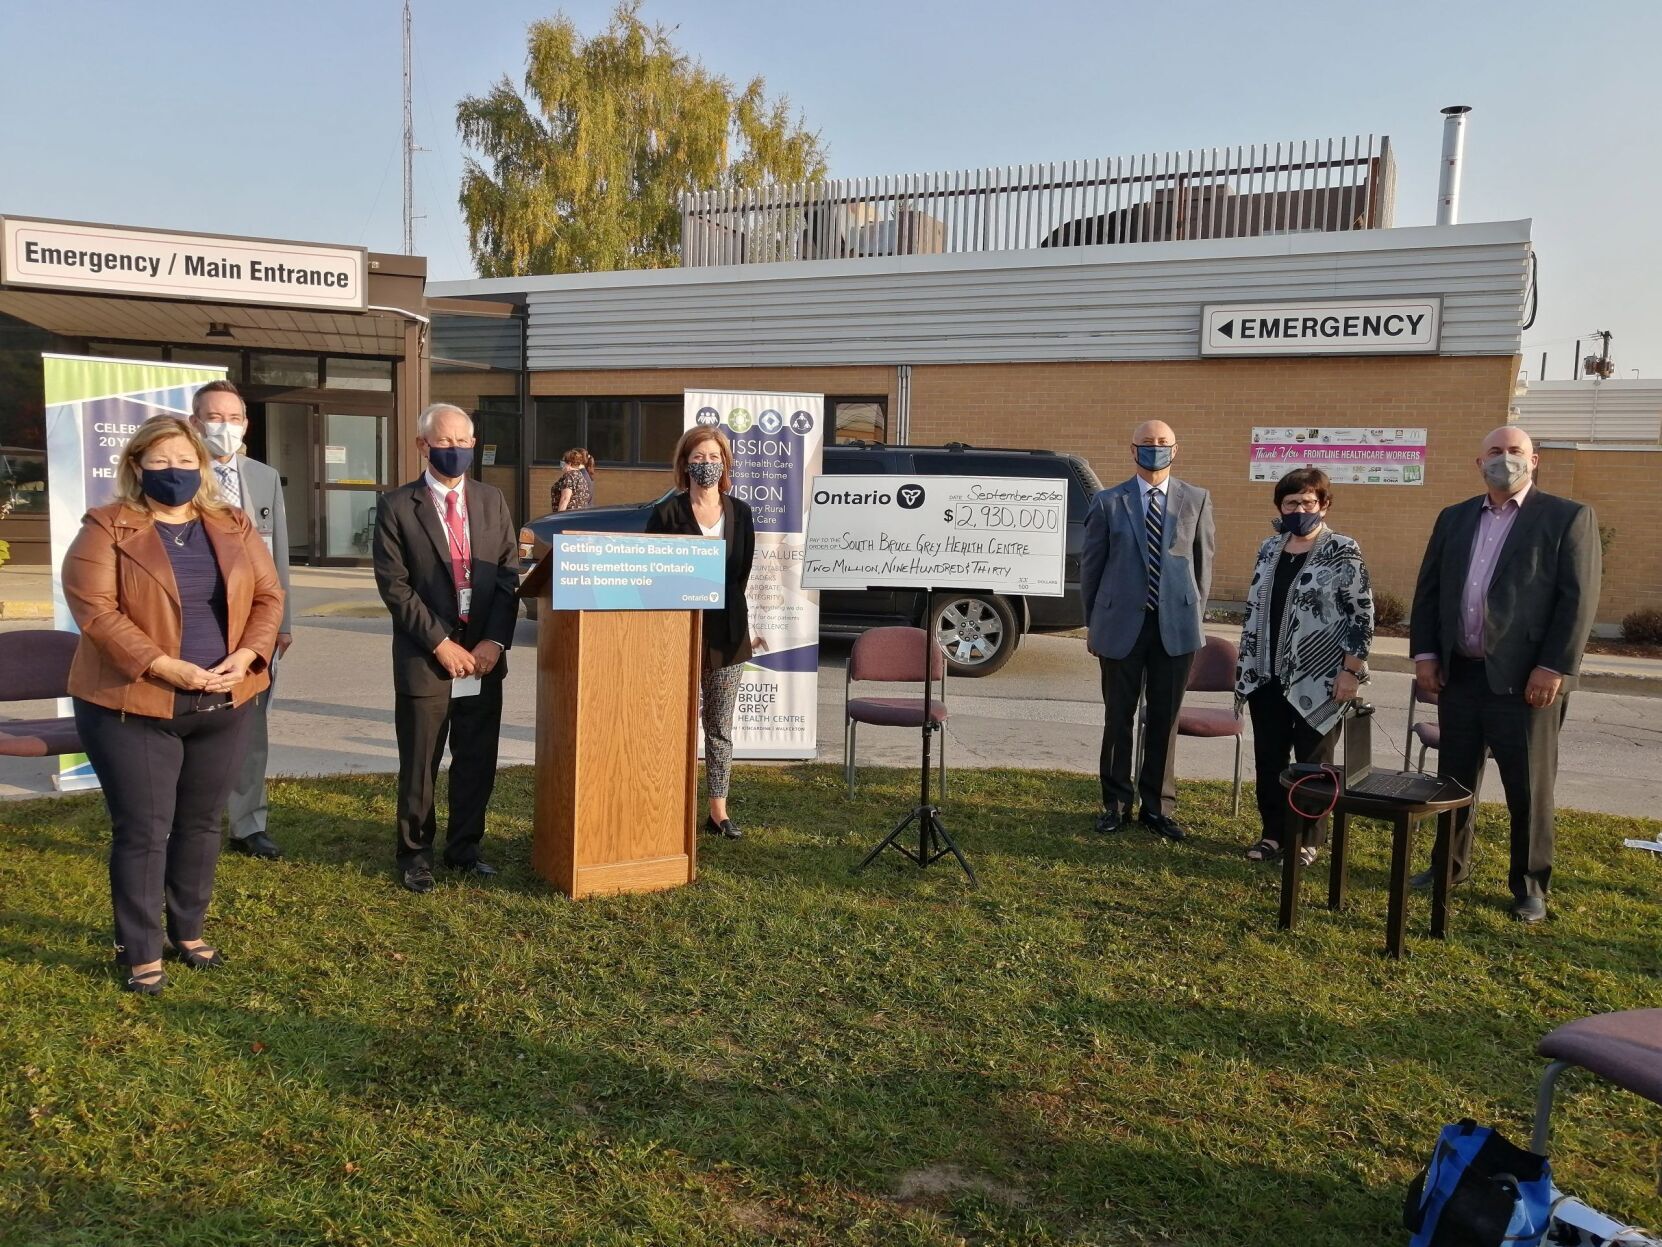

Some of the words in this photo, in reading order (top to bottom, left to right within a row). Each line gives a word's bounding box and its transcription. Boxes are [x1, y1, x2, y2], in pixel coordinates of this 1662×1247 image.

[24, 240, 161, 278] Emergency
[184, 255, 242, 280] Main
[250, 260, 349, 288] Entrance
[1240, 313, 1425, 339] EMERGENCY
[728, 439, 792, 456] ISSION
[1255, 446, 1278, 460] Thank
[1279, 445, 1299, 462] You
[1303, 449, 1340, 459] FRONTLINE
[1341, 450, 1385, 460] HEALTHCARE
[1385, 451, 1421, 460] WORKERS
[744, 459, 772, 468] Health
[773, 460, 794, 469] Care
[729, 470, 750, 478] Close
[751, 471, 760, 479] to
[762, 471, 788, 480] Home
[967, 484, 1032, 501] September
[813, 490, 892, 506] Ontario
[764, 504, 786, 513] Rural
[756, 515, 777, 524] Care
[560, 542, 603, 556] Getting
[605, 544, 646, 554] Ontario
[648, 544, 674, 555] Back
[676, 547, 689, 555] on
[691, 545, 719, 556] Track
[762, 550, 804, 560] VALUES
[560, 561, 590, 572] Nous
[592, 563, 648, 573] remettons
[650, 562, 695, 573] l'Ontario
[752, 564, 788, 572] OUNTABLE
[560, 577, 578, 585] sur
[581, 575, 592, 585] la
[594, 575, 628, 586] bonne
[630, 576, 653, 586] voie
[681, 594, 709, 602] Ontario
[739, 683, 778, 692] SOUTH
[739, 693, 776, 703] BRUCE
[738, 704, 769, 713] GREY
[738, 714, 770, 723] HEALTH
[773, 715, 806, 723] CENTRE
